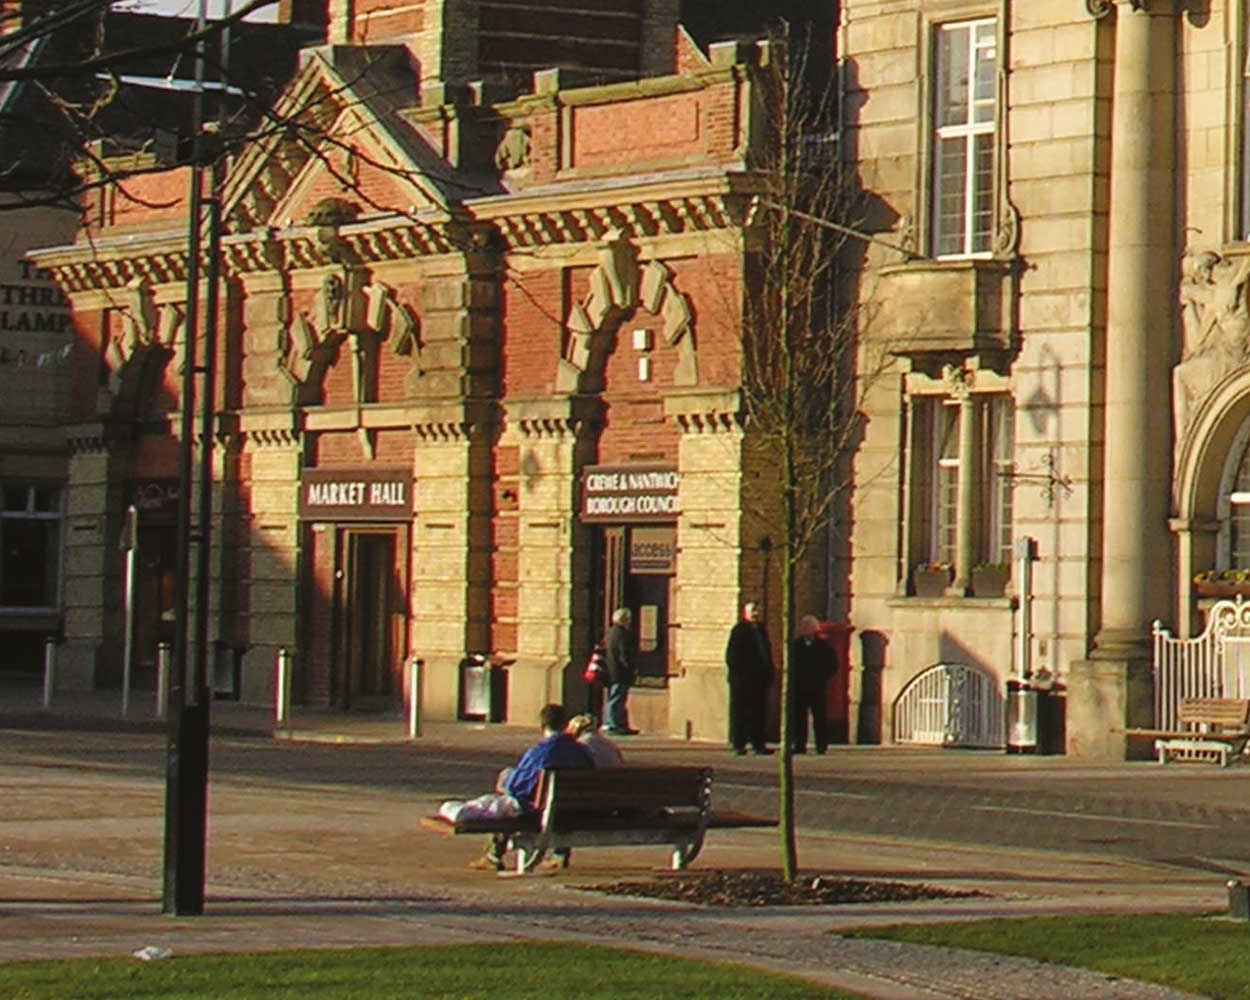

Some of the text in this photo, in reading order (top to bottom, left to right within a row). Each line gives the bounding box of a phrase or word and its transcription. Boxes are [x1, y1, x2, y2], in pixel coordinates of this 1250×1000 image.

[308, 482, 405, 505] MARKET HALL
[587, 497, 636, 514] BOROUGH
